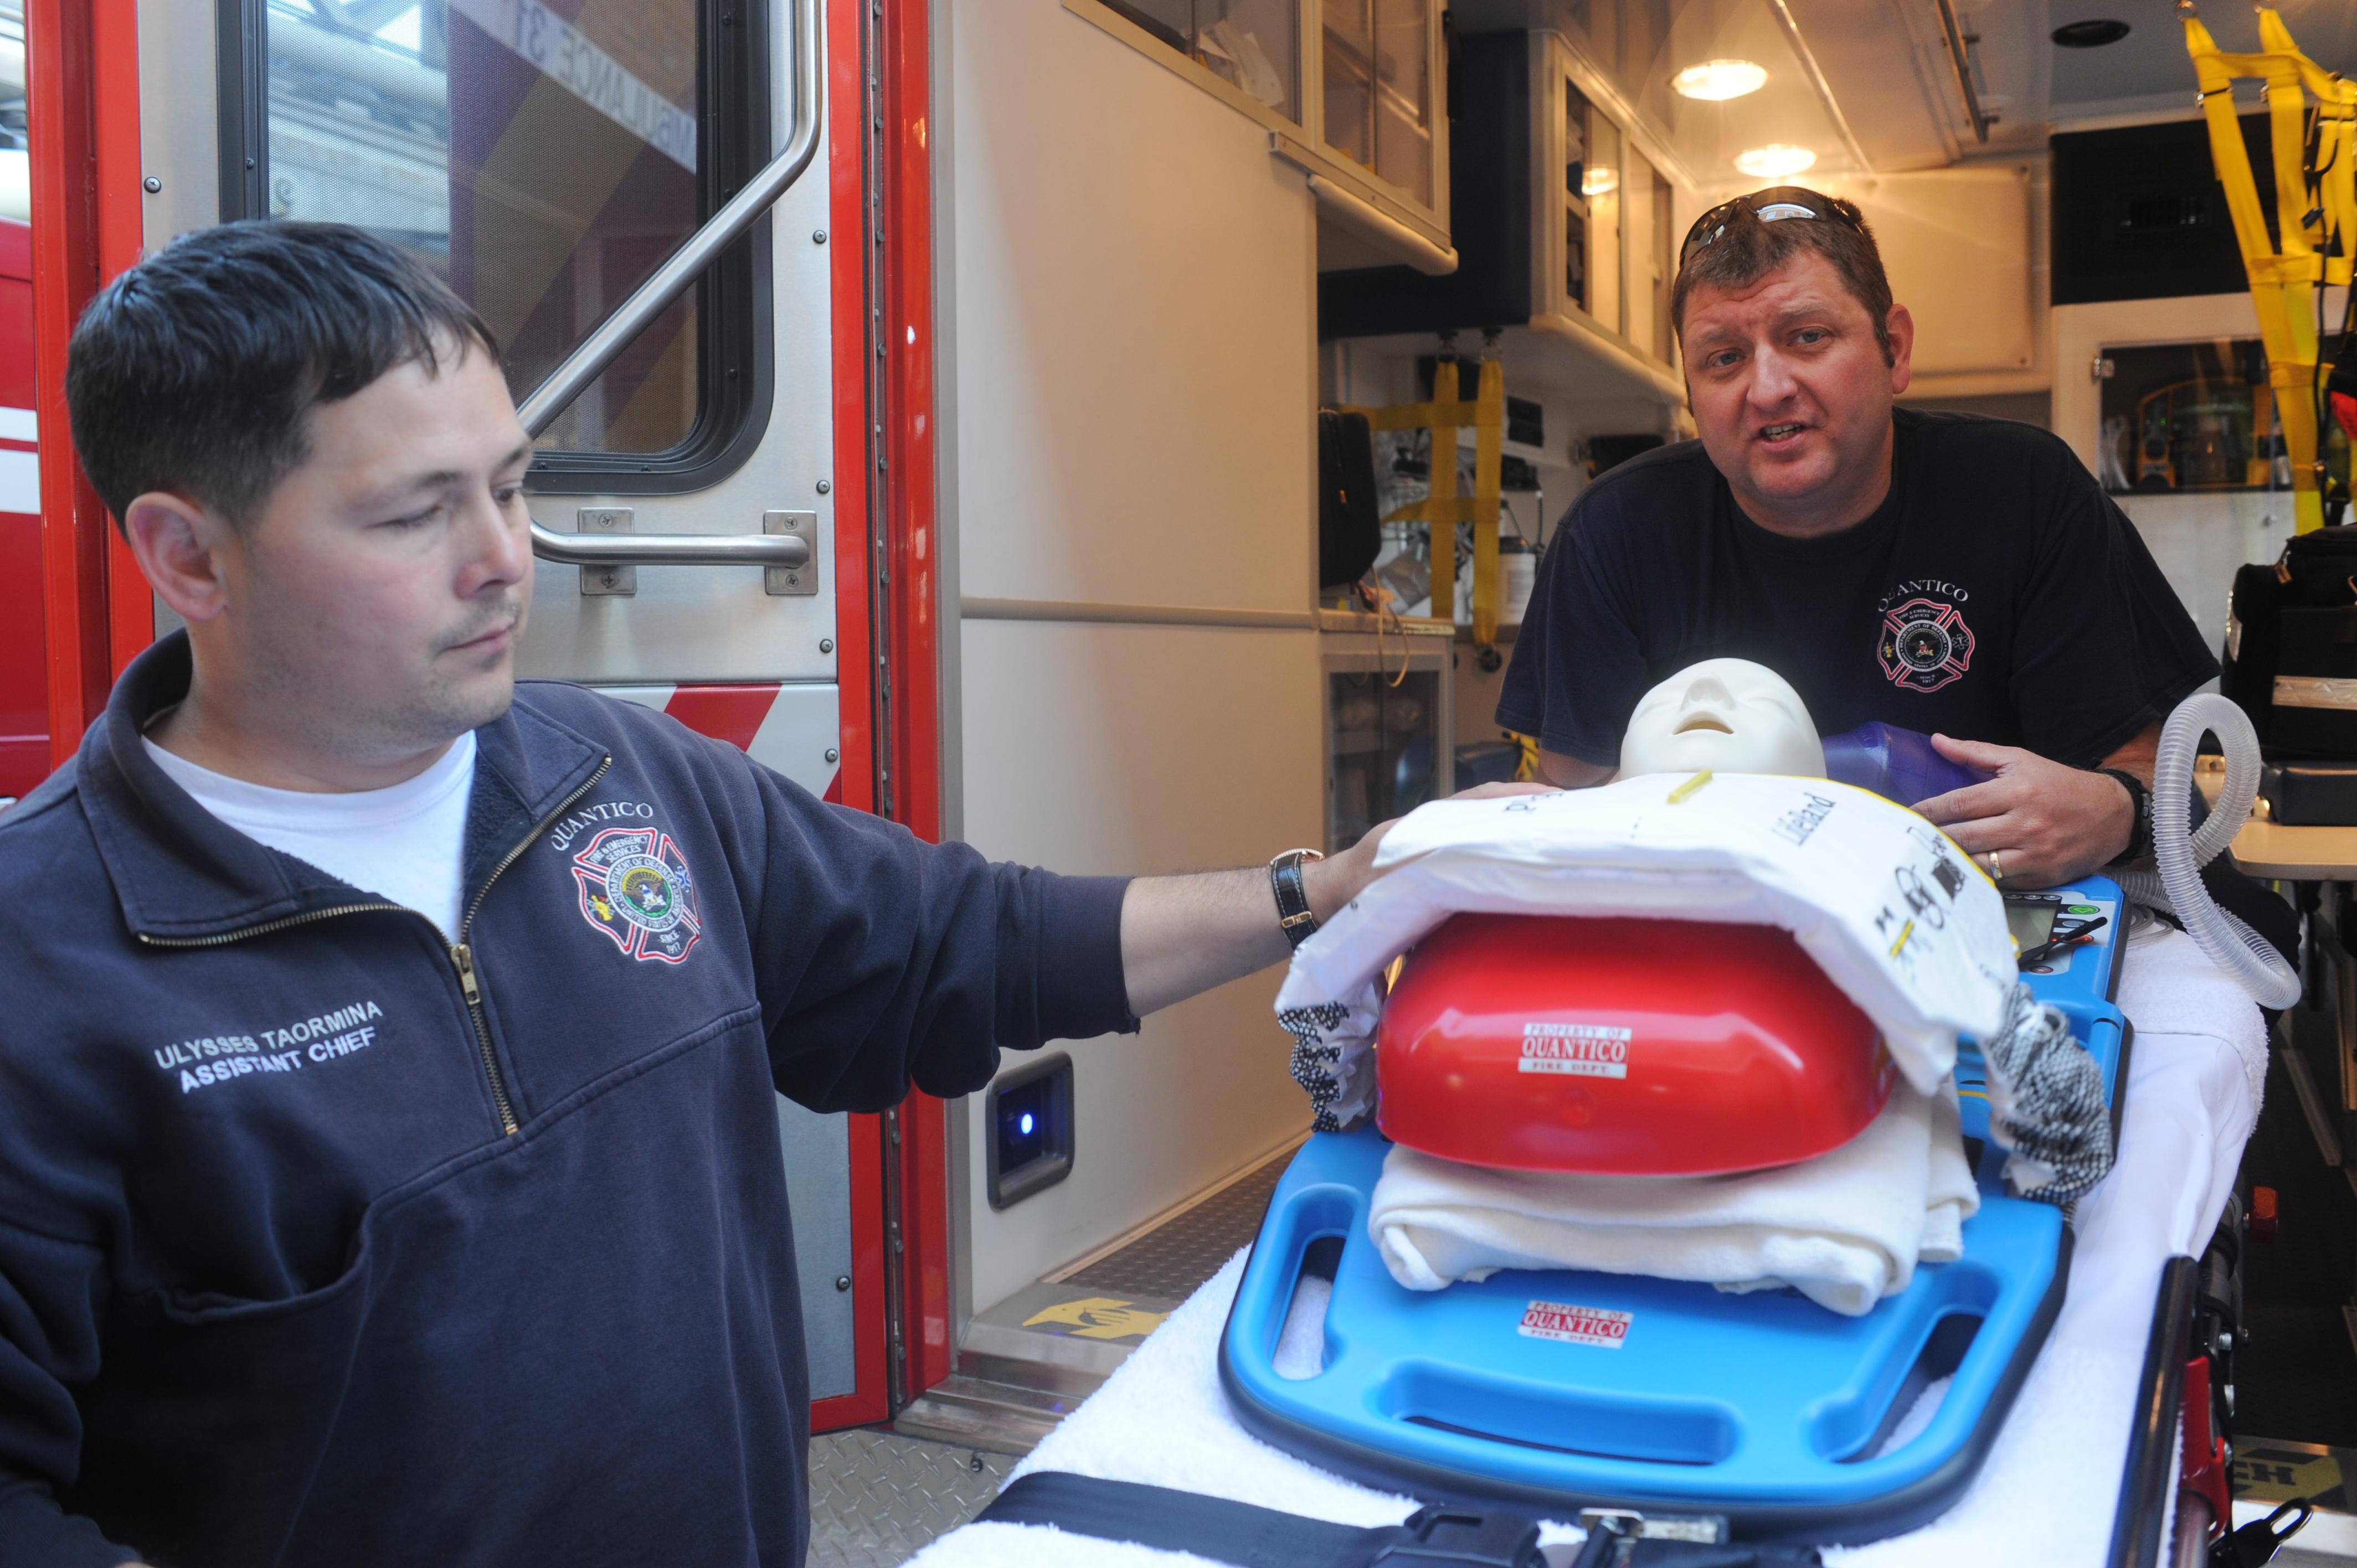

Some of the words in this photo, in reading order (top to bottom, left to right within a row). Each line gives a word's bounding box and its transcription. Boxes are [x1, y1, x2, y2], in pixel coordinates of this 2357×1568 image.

[1879, 580, 1968, 612] QUANTICO
[1899, 623, 1921, 648] DEPARTMENT
[1931, 625, 1948, 644] DEFENSE
[551, 802, 654, 851] QUANTICO
[605, 835, 649, 852] EMERGENCY
[605, 844, 642, 864] SERVICES
[610, 859, 632, 903] DEPARTMENT
[632, 858, 643, 866] OF
[644, 858, 675, 885] DEFENSE
[660, 930, 680, 943] SINCE
[666, 942, 681, 954] 1917
[155, 1035, 259, 1069] ULYSSES
[260, 1000, 383, 1049] TAORMINA
[180, 1050, 302, 1094] ASSISTANT
[307, 1025, 375, 1062] CHIEF
[1522, 1036, 1626, 1062] QUANTICO
[1532, 1062, 1562, 1070] FIRE
[1533, 1302, 1599, 1319] PROPERTY
[1608, 1311, 1625, 1321] OF
[1523, 1311, 1625, 1338] QUANTICO
[1531, 1329, 1561, 1339] FIRE
